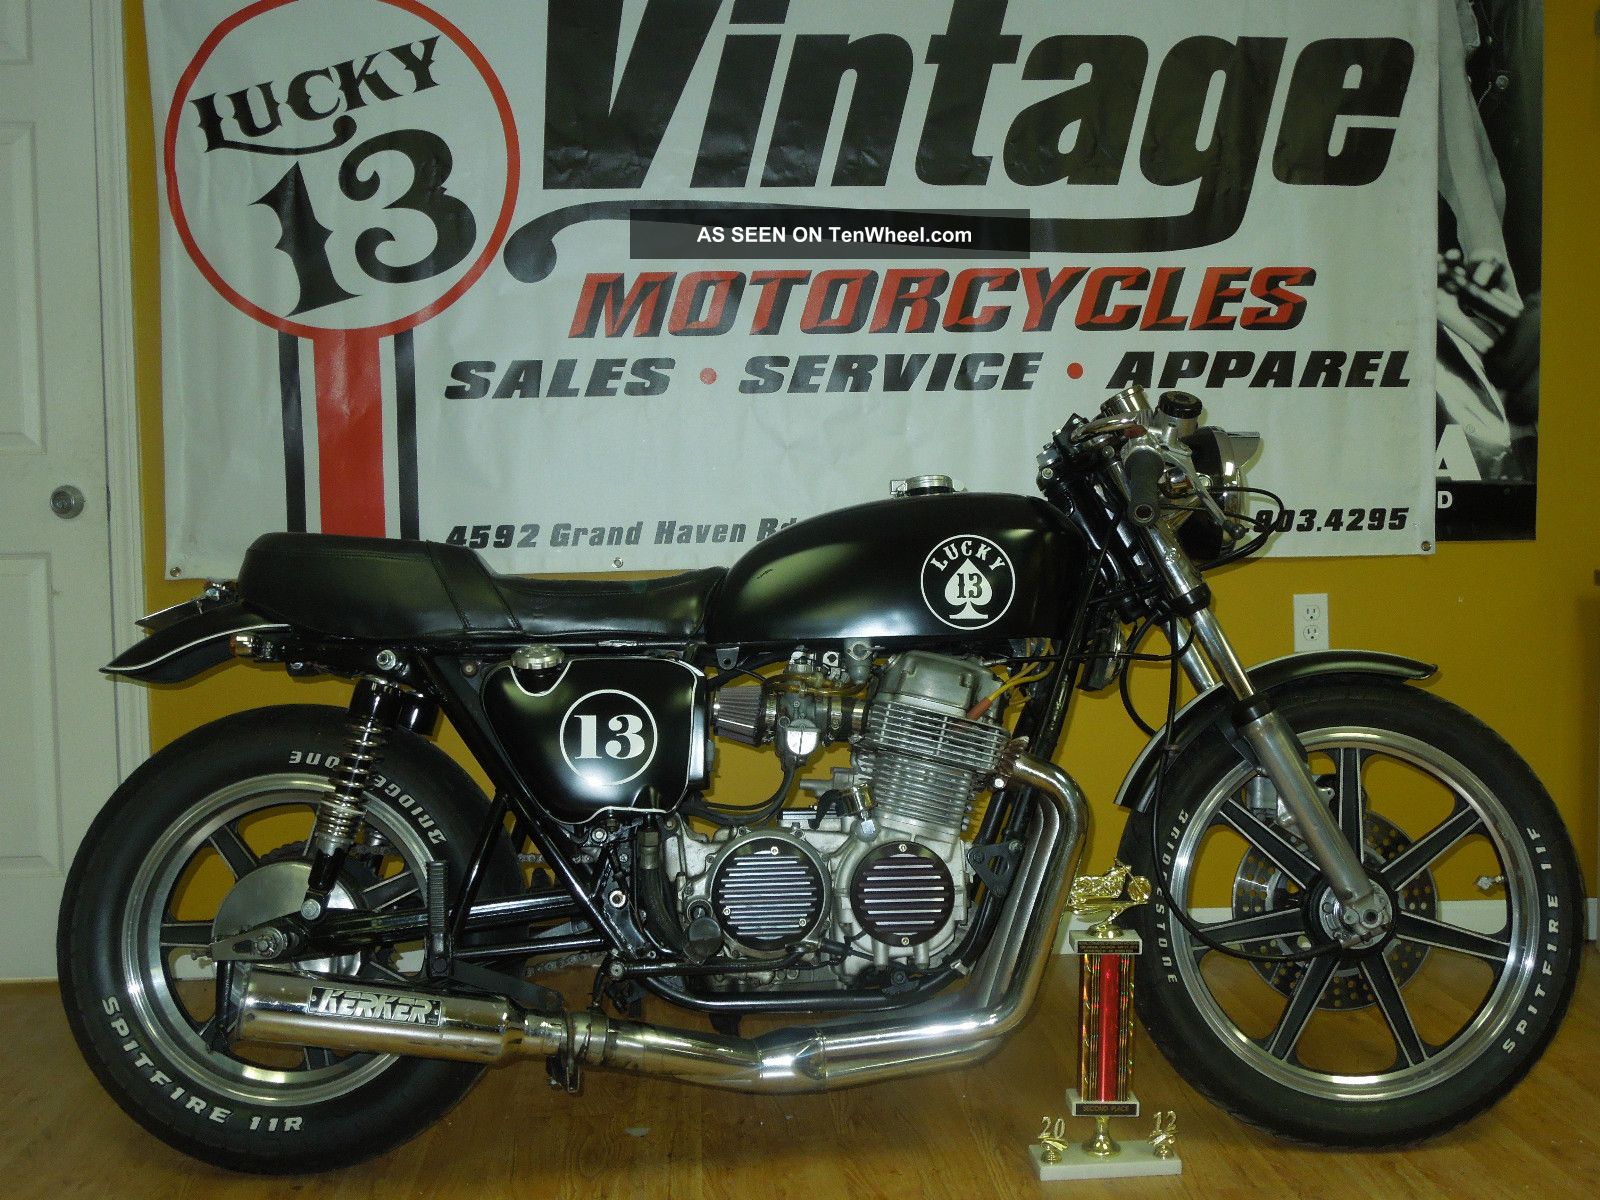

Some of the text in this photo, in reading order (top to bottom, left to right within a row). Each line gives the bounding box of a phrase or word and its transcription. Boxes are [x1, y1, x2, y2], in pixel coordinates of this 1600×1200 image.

[188, 35, 441, 156] LUCKY
[503, 0, 1415, 283] Vintage
[247, 128, 477, 318] 13
[568, 266, 1317, 339] MOTORCYCLES
[444, 350, 1411, 400] SALES SERVICE APPAREL
[446, 524, 541, 549] 4592
[549, 521, 644, 548] Grand
[654, 520, 747, 545] Haven
[930, 540, 1006, 572] LUCKY
[956, 572, 983, 599] 13
[573, 714, 646, 760] 13
[1503, 894, 1560, 1054] SPITFIRE
[318, 989, 433, 1024] KERKER
[102, 996, 304, 1132] SPITFIRE 11R
